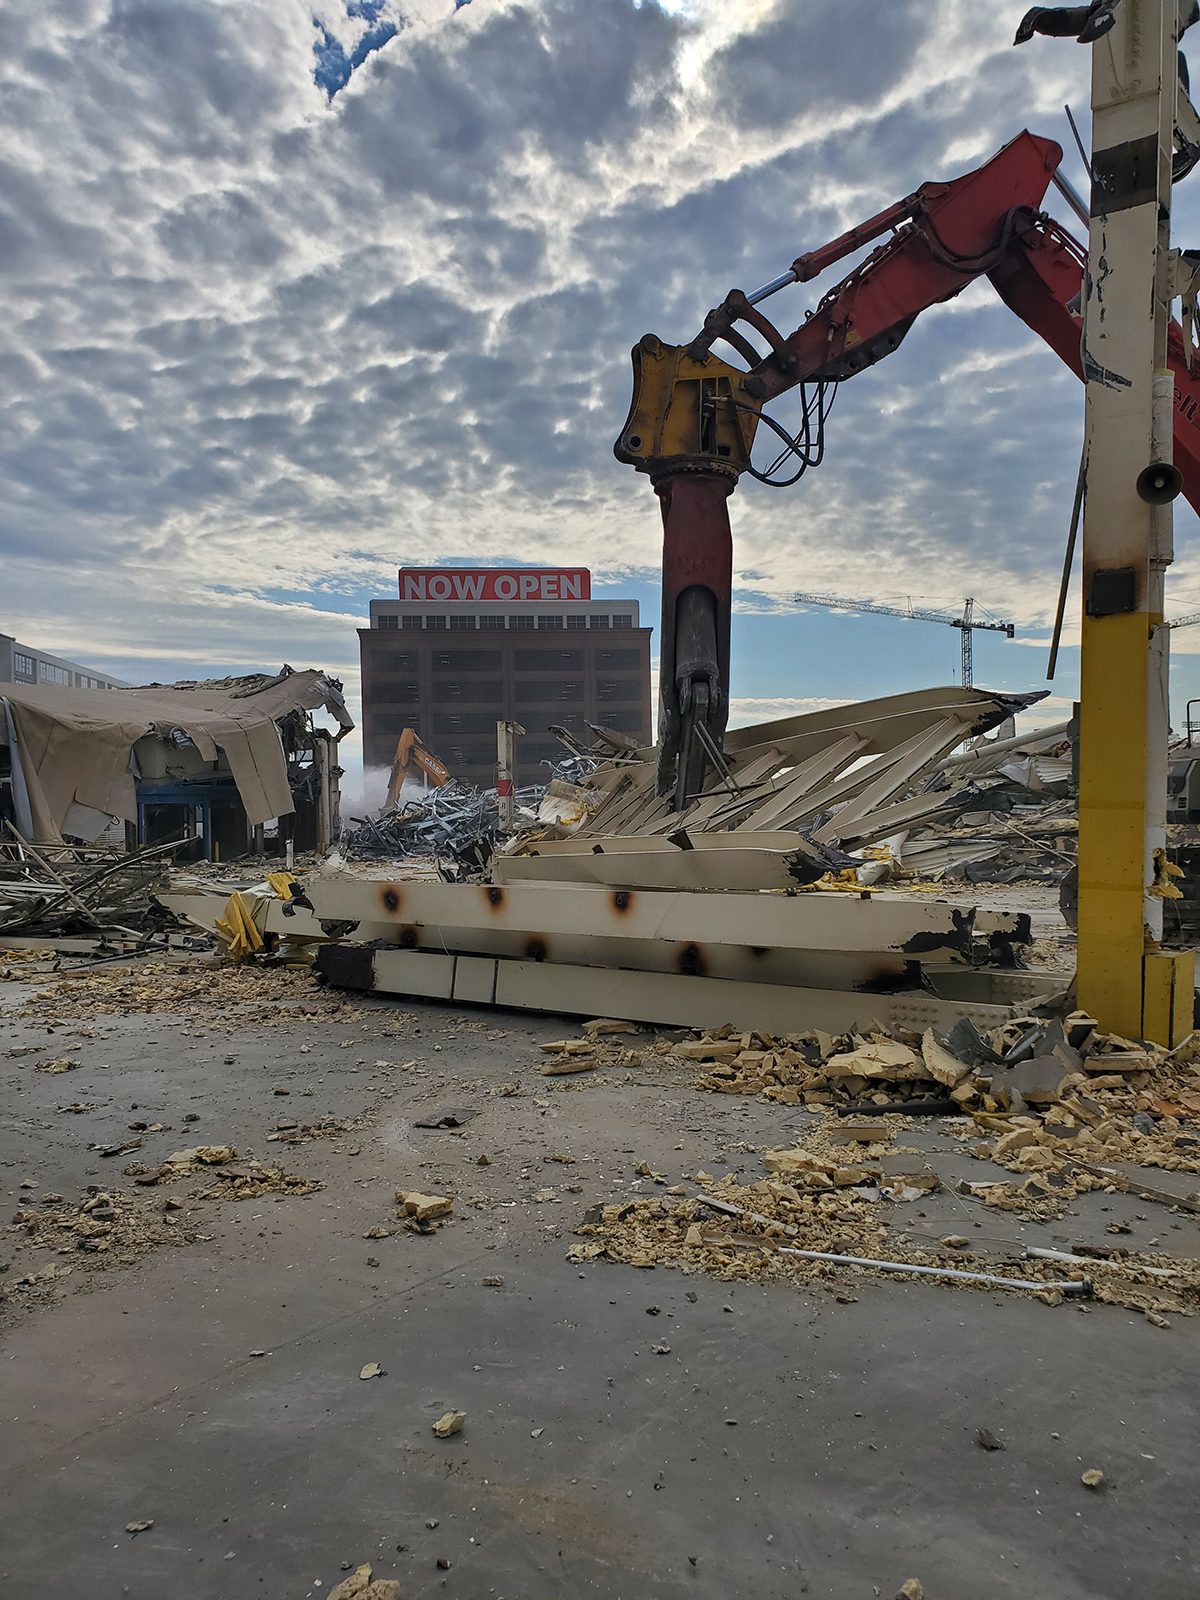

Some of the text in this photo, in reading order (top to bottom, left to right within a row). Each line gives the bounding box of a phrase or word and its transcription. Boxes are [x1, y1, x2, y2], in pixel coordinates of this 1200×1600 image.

[403, 574, 582, 600] NOW OPEN
[424, 757, 441, 774] CASE
